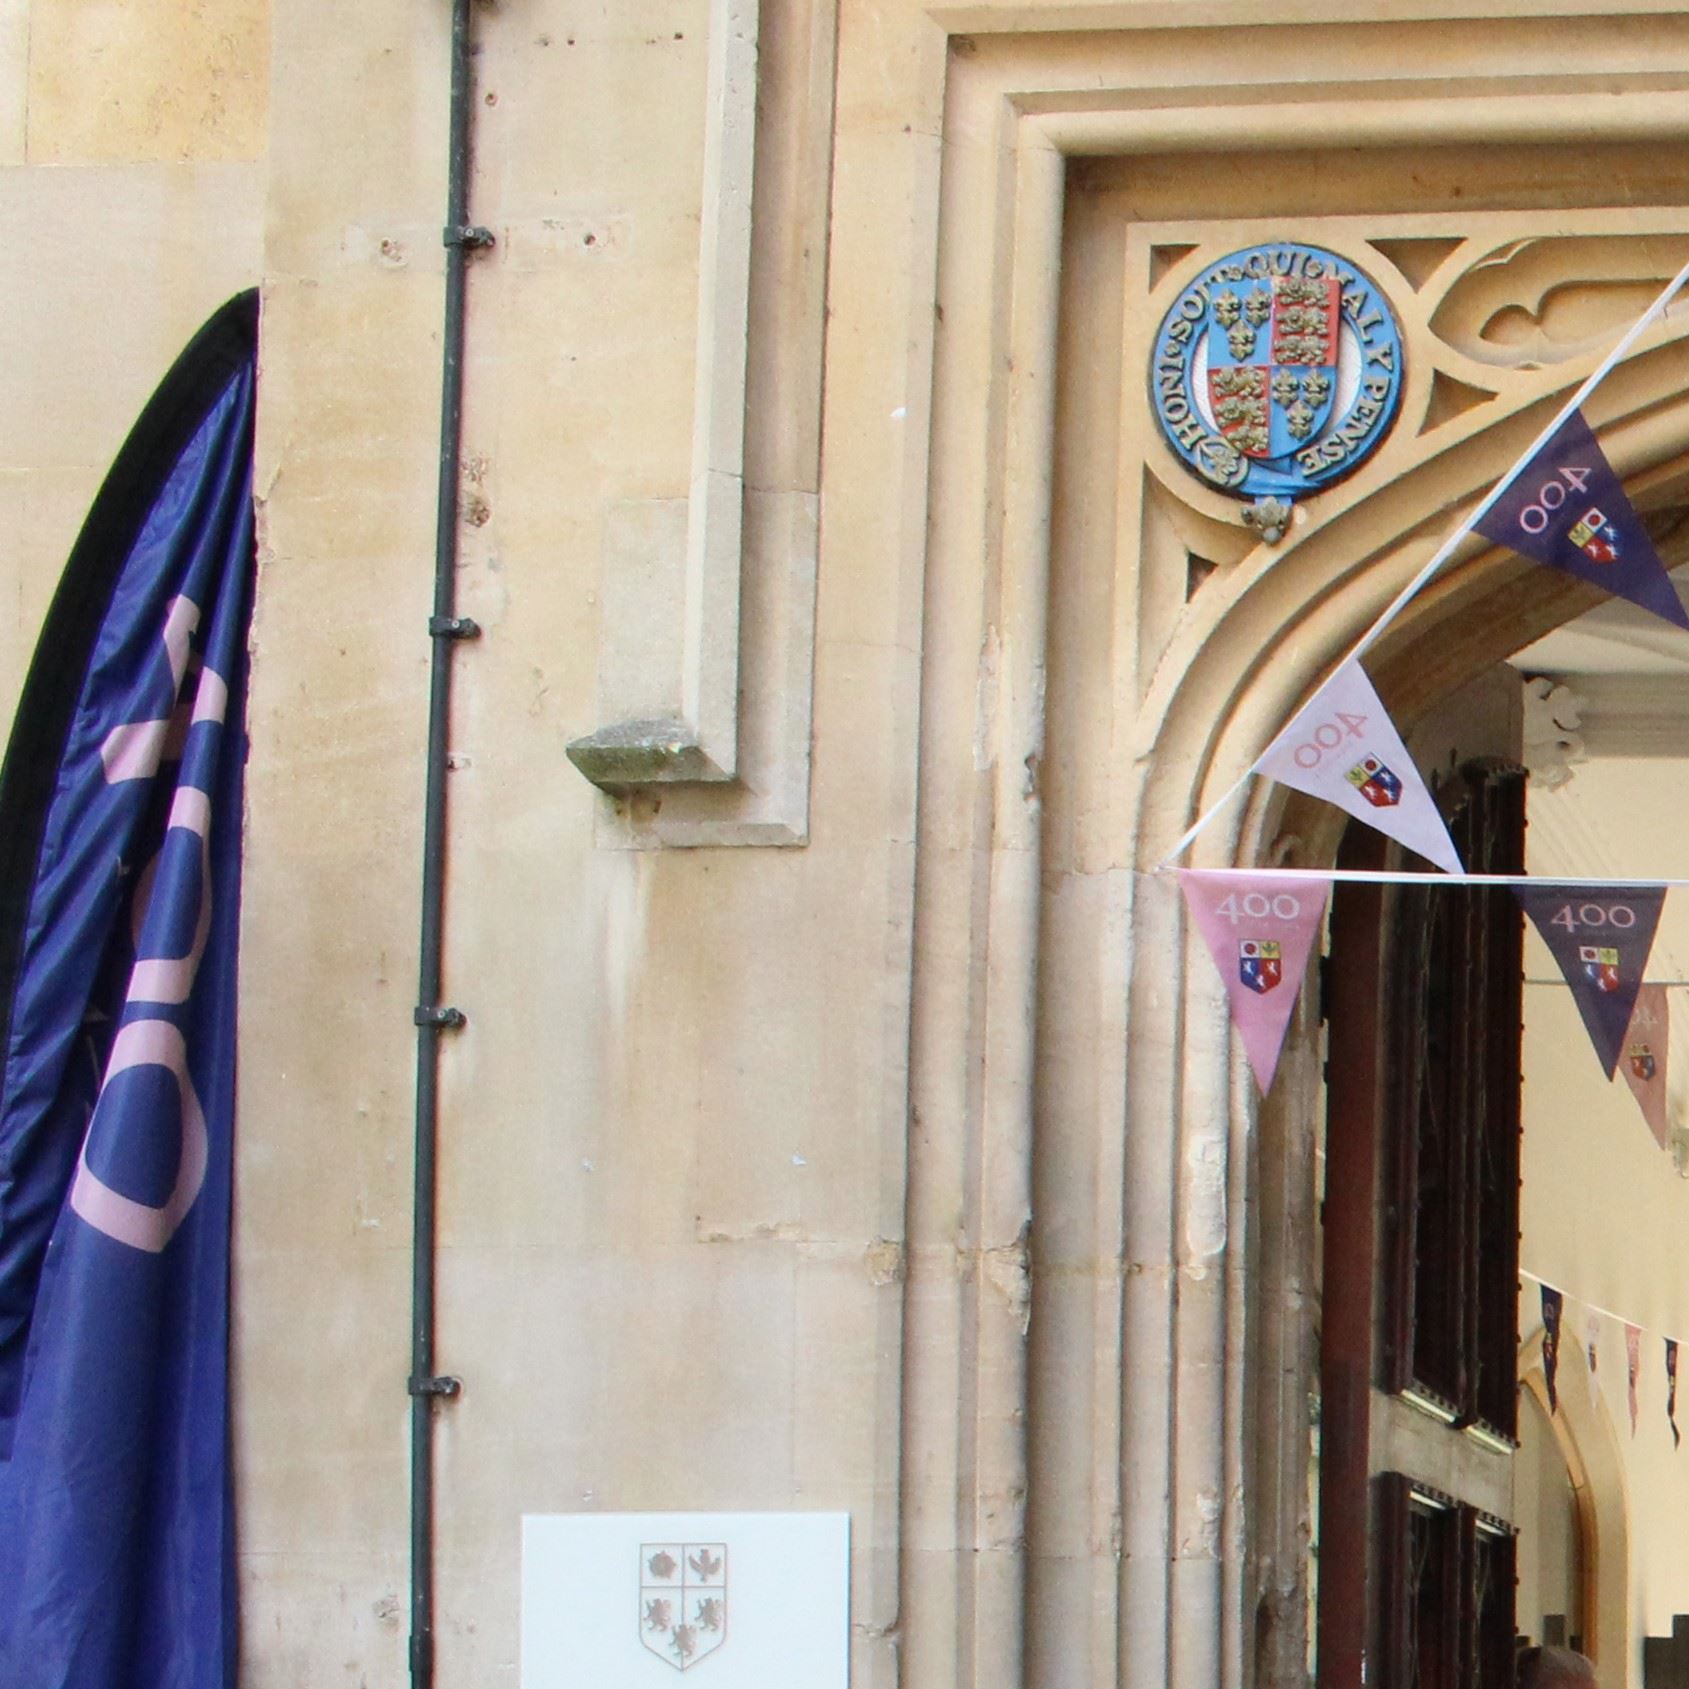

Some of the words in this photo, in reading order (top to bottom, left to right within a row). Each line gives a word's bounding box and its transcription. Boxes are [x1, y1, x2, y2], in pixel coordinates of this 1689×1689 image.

[1159, 355, 1202, 449] HONI
[1244, 250, 1312, 280] QUI
[1298, 376, 1390, 477] PENSE
[1214, 893, 1301, 924] 400
[1550, 903, 1636, 933] 400
